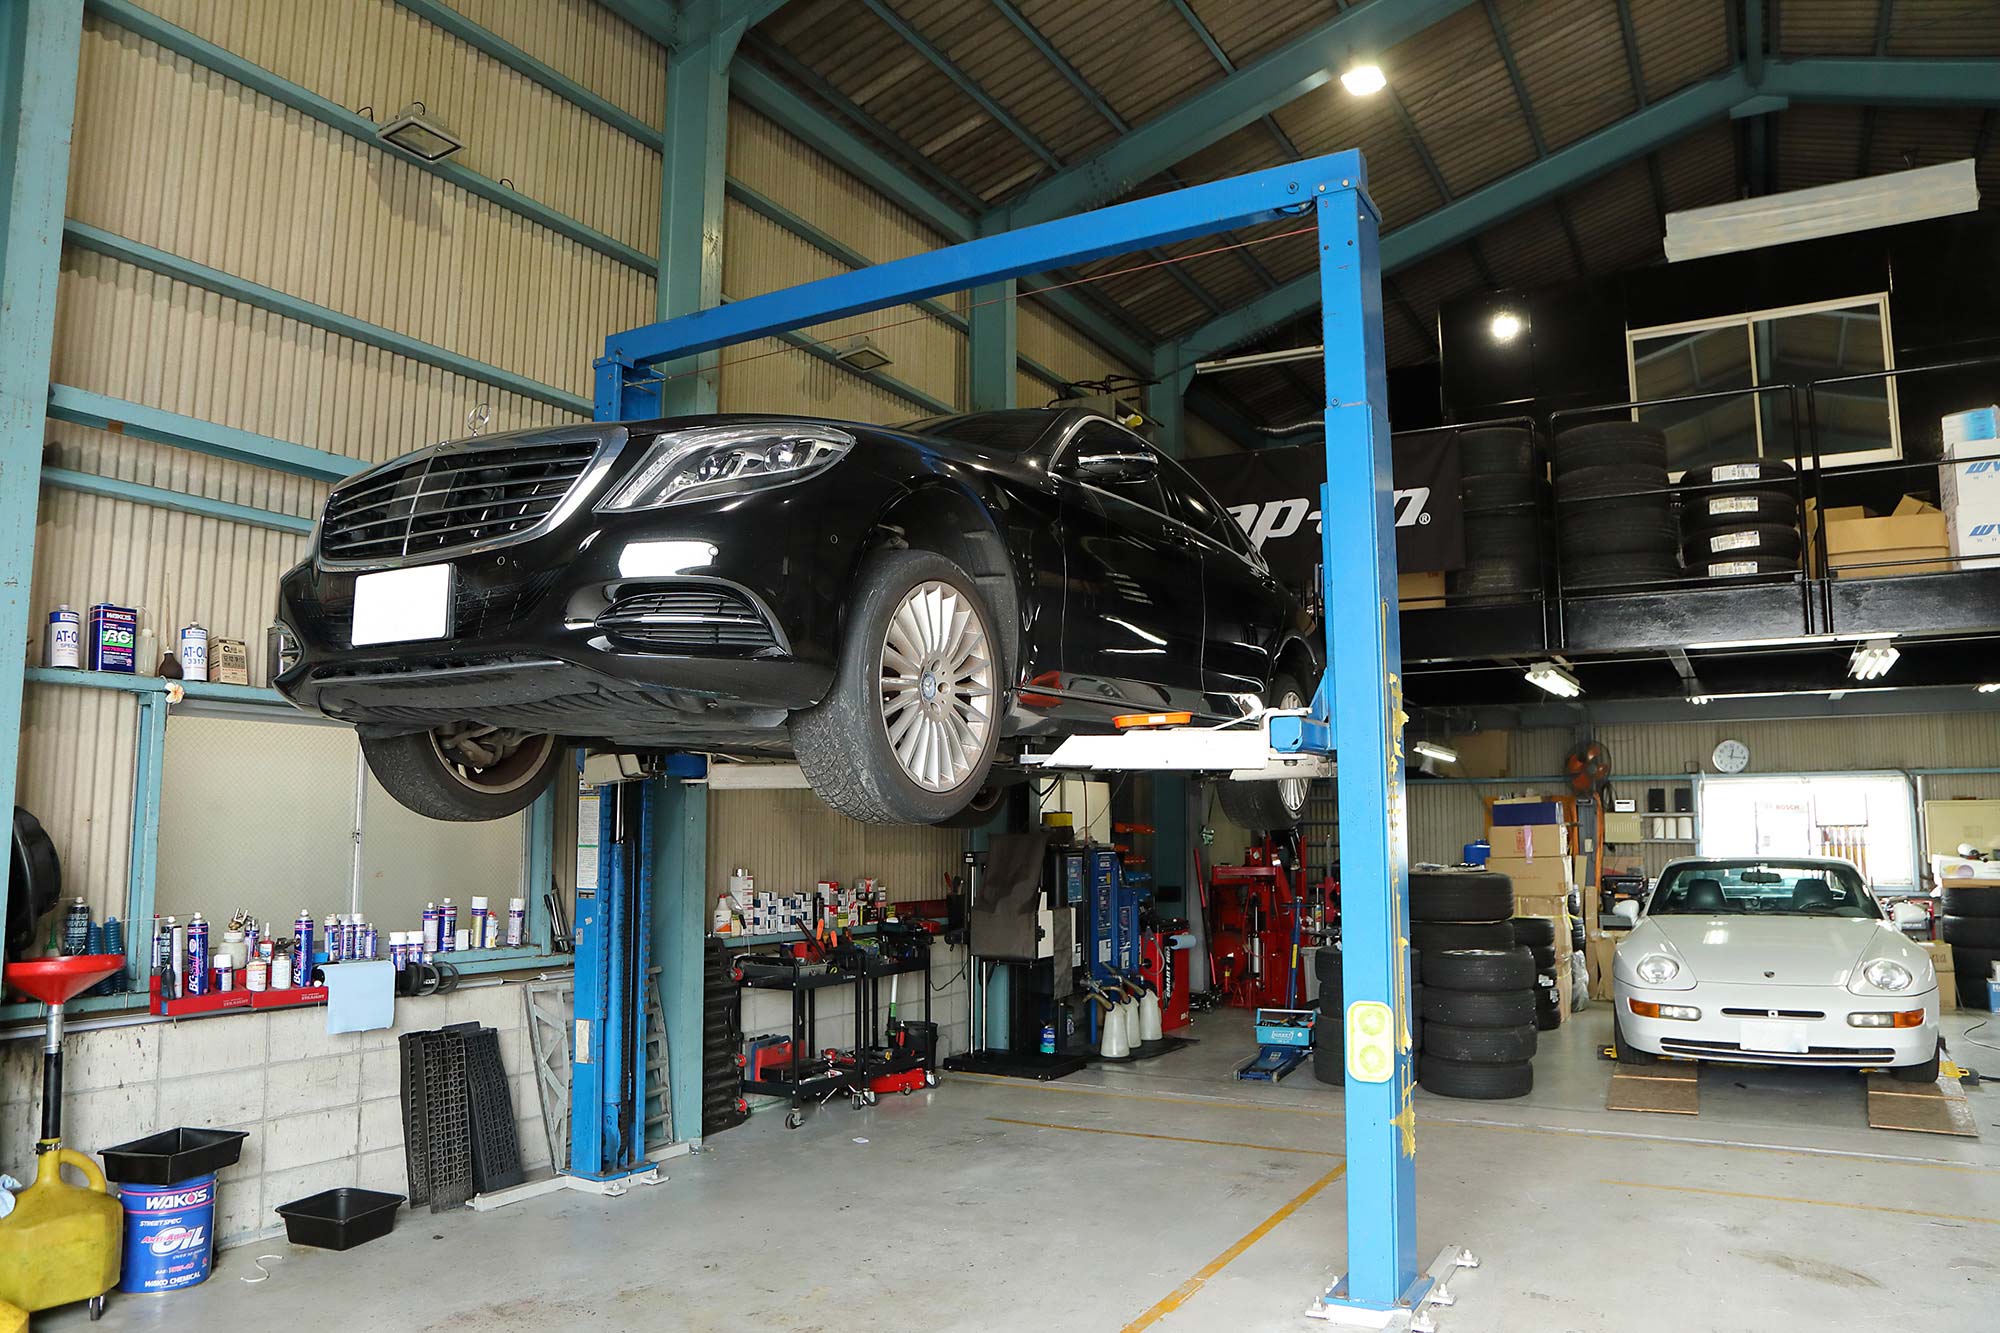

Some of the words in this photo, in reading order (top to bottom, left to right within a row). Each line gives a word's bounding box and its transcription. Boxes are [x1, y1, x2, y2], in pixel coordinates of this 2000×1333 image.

[1226, 486, 1431, 551] ap-n
[146, 1189, 207, 1210] WAKO'S
[150, 1225, 206, 1255] OIL
